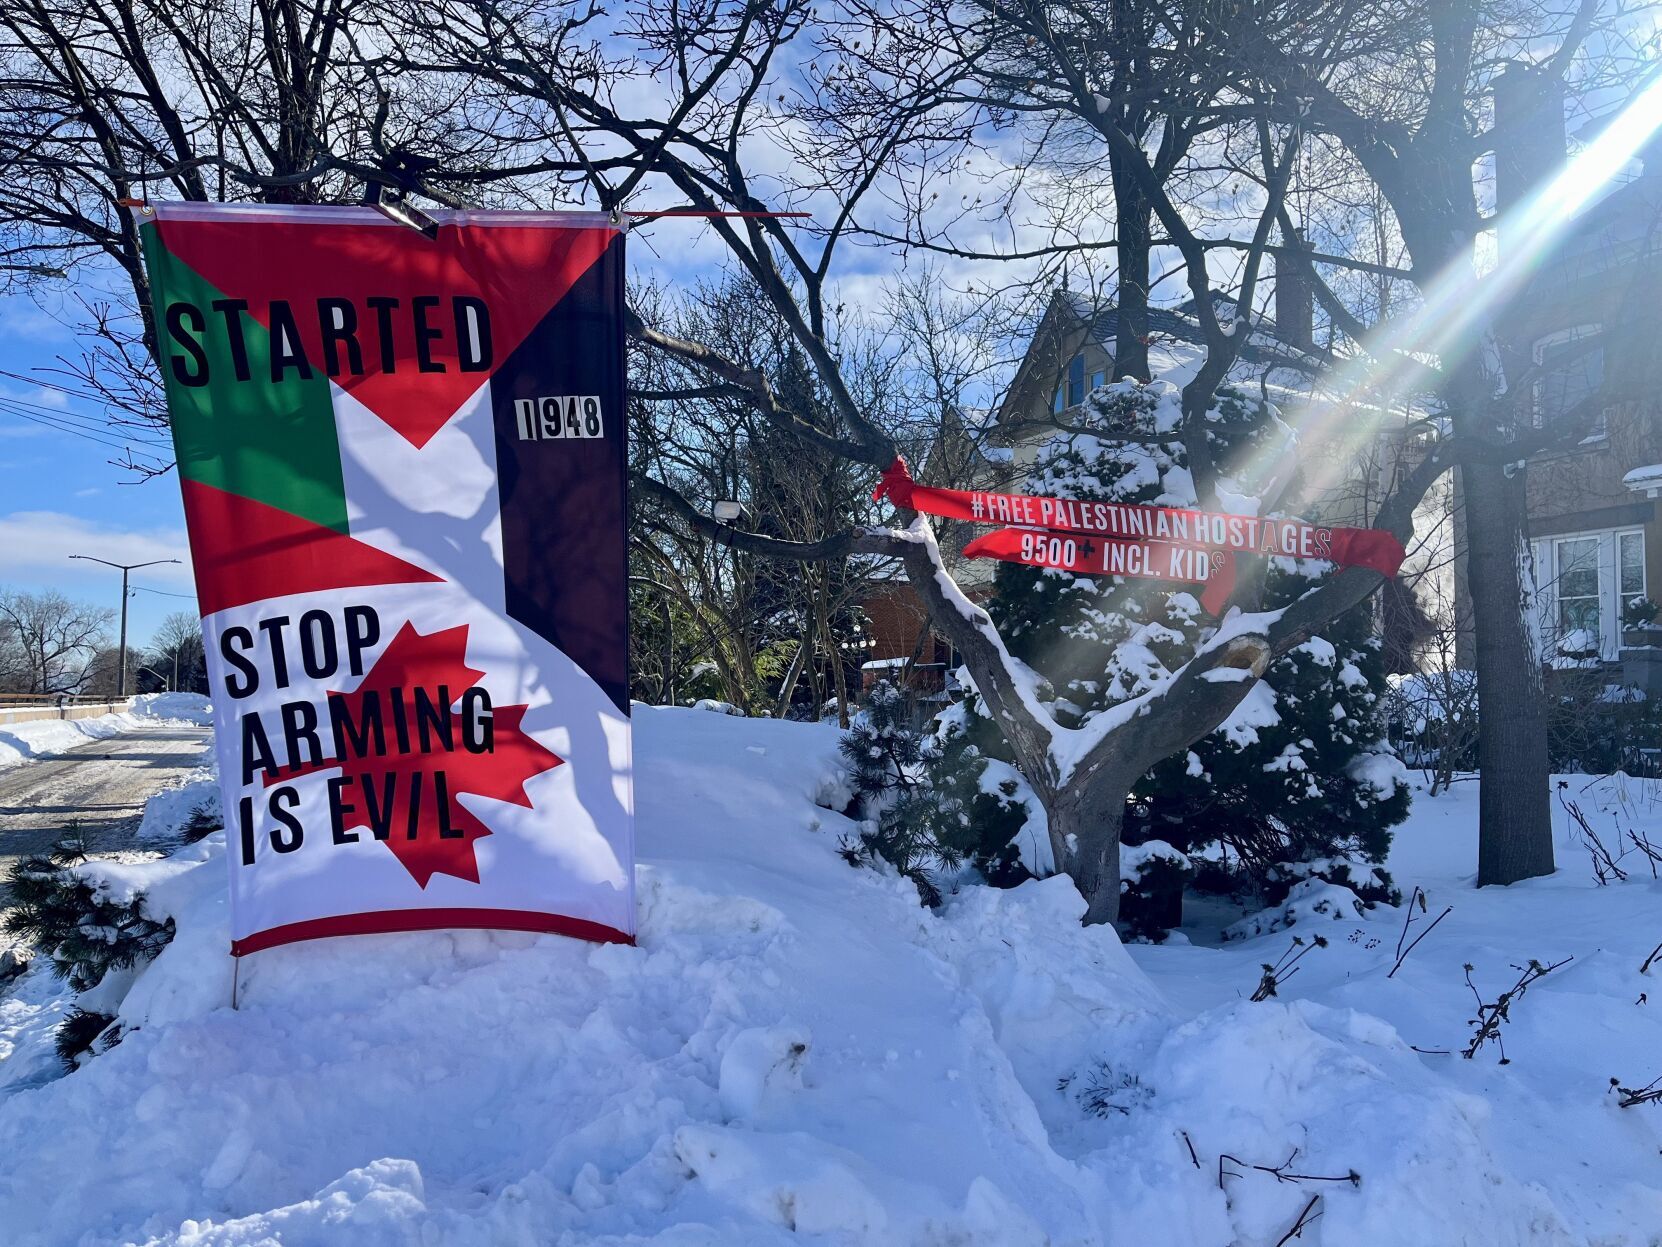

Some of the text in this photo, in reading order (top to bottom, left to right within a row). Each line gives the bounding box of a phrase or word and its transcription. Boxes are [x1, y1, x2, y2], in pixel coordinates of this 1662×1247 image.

[165, 296, 494, 388] STARTED
[522, 397, 600, 439] 1948
[971, 492, 1332, 558] #FREE PALESTINIAN HOSTAGES
[1103, 541, 1161, 577] INCL.
[219, 604, 381, 700] STOP
[241, 685, 495, 787] ARMING
[239, 770, 465, 866] IS EVIL
